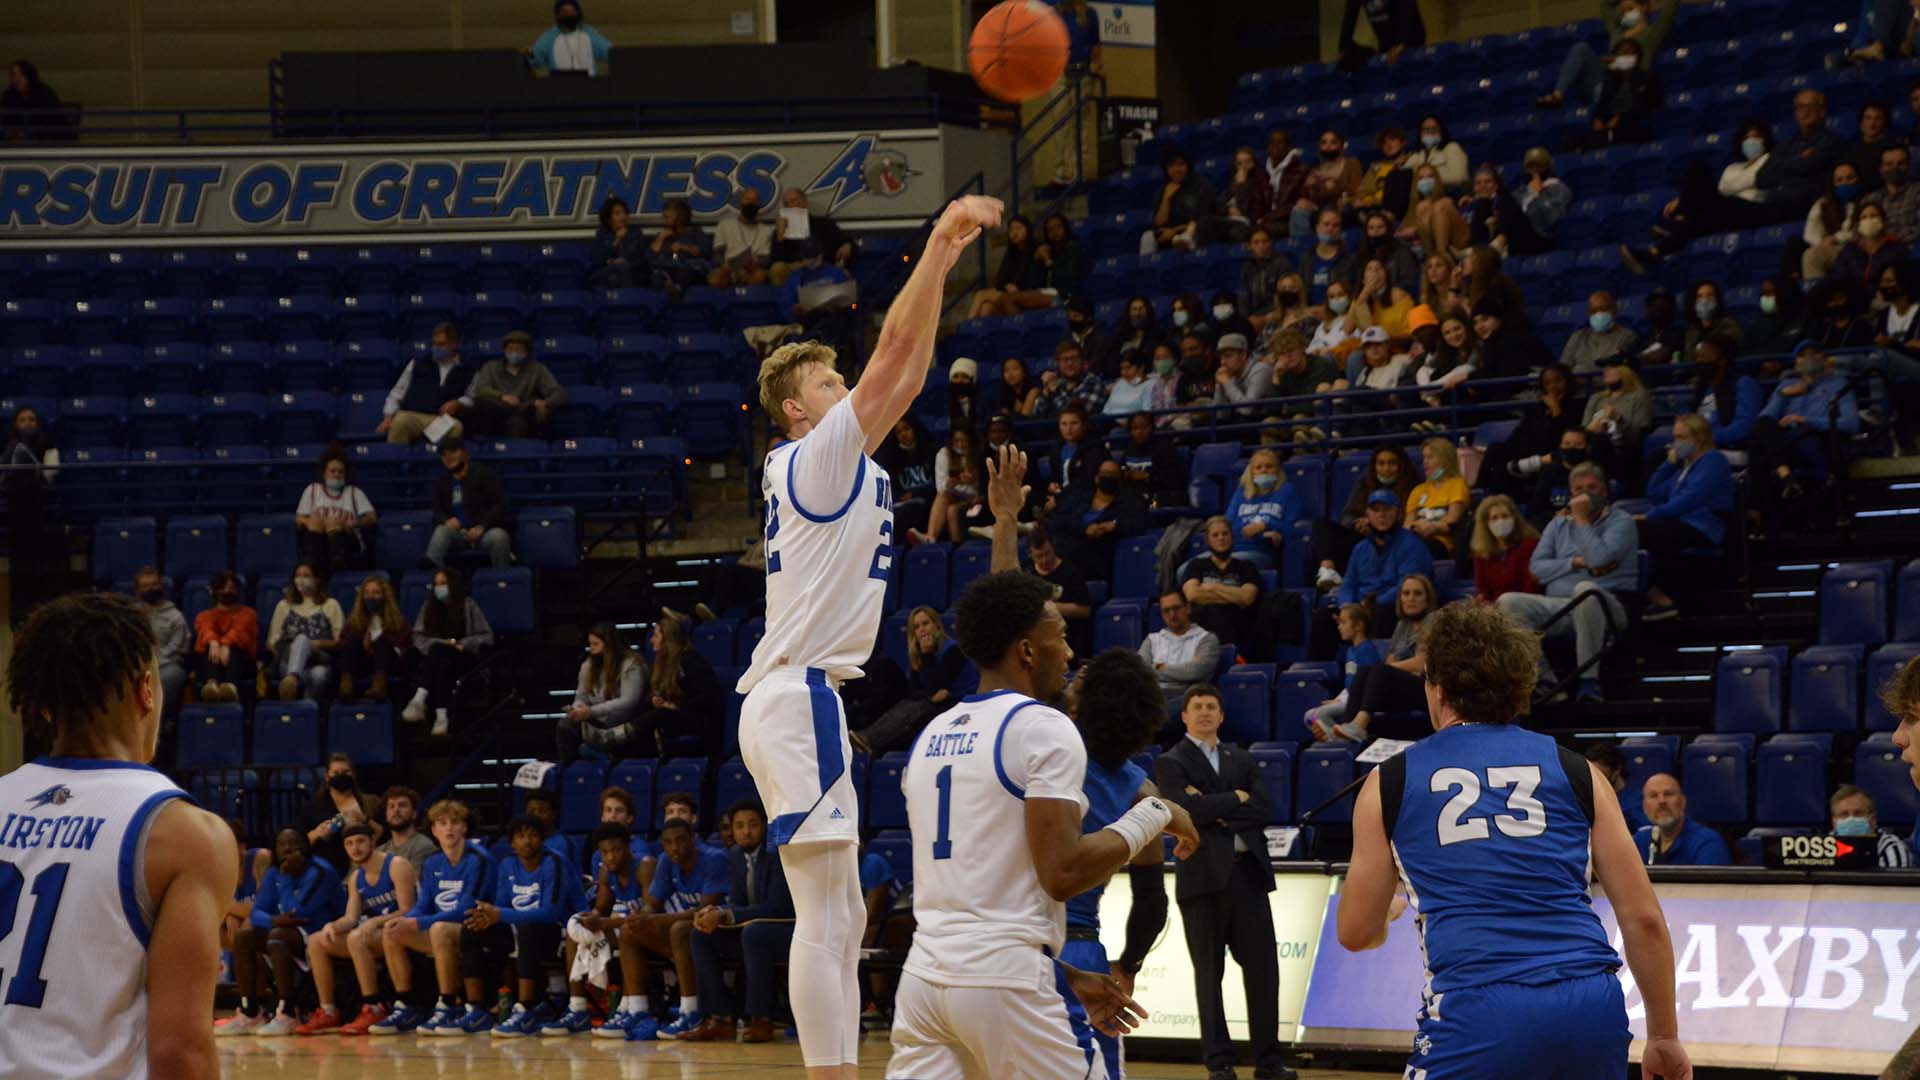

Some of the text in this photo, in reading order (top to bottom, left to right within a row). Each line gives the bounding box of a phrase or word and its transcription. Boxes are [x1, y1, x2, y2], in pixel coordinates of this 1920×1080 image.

[1119, 105, 1158, 120] TRASH
[0, 152, 787, 227] RSUIT OF GREATNESS
[765, 491, 782, 575] 2
[925, 732, 979, 758] BATTLE
[932, 764, 953, 860] 1
[1429, 764, 1548, 848] 23
[0, 812, 106, 851] IRSTON
[1781, 835, 1837, 858] POSS
[1277, 941, 1308, 960] OM
[1151, 1010, 1199, 1028] Company
